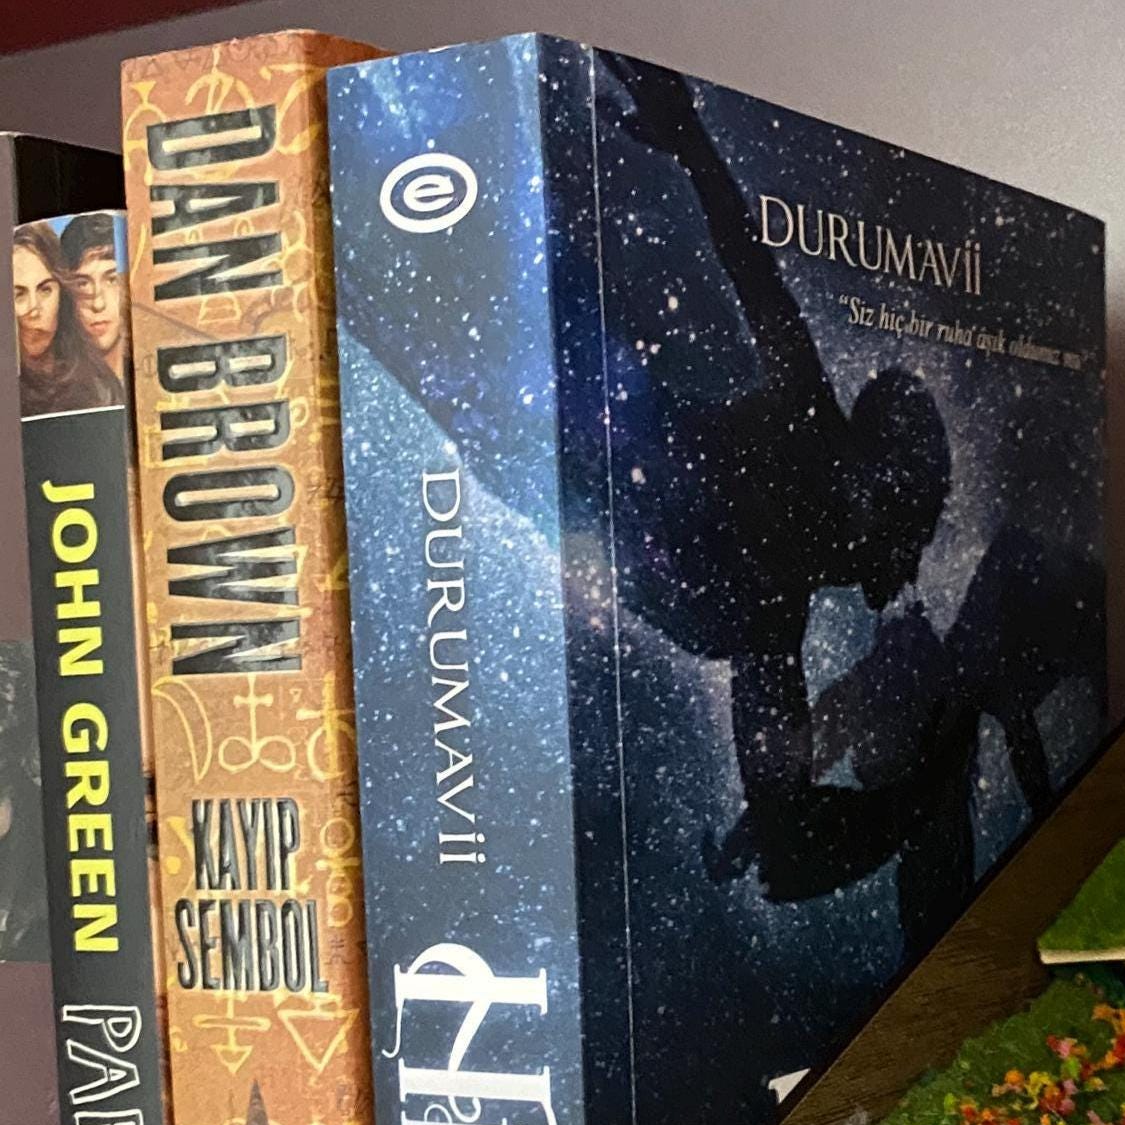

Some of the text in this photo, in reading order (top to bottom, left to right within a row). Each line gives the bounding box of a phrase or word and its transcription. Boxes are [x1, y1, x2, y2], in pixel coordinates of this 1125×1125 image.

[147, 104, 303, 675] DAN BROWN
[41, 480, 120, 952] JOHN GREEN
[191, 797, 302, 891] KAYIP
[174, 898, 328, 992] SEMBOL
